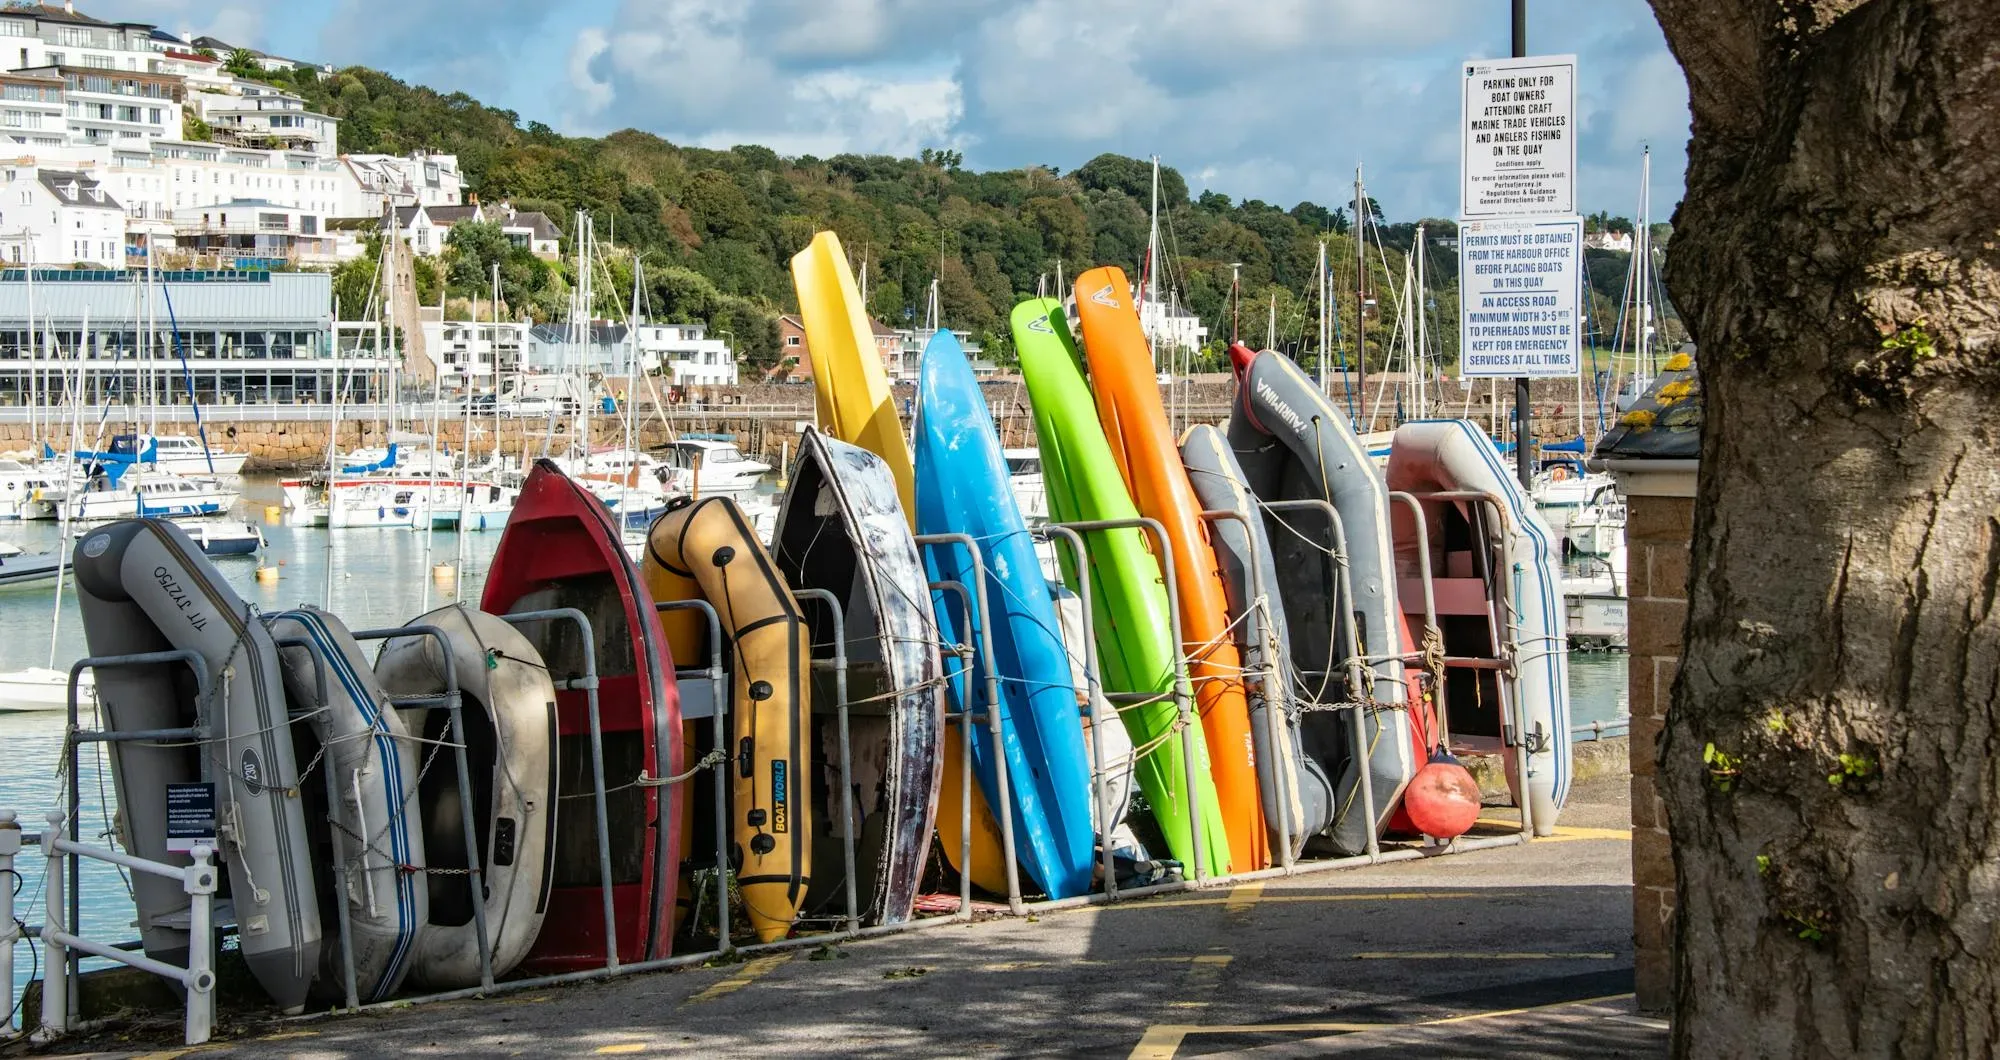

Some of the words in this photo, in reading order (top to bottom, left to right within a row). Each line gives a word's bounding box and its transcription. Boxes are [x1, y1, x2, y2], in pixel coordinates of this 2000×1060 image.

[1484, 78, 1515, 90] PARKING
[1518, 77, 1537, 88] ONLY
[1540, 76, 1554, 86] FOR
[1492, 92, 1510, 102] BOAT
[1514, 90, 1545, 102] OWNERS
[1484, 105, 1525, 116] ATTENDING
[1529, 103, 1552, 114] CRAFT
[1472, 120, 1499, 130] MARINE
[1504, 118, 1526, 129] TRADE
[1530, 116, 1565, 127] VEHICLES
[1476, 134, 1491, 143] AND
[1494, 131, 1528, 143] ANGLERS
[1531, 130, 1561, 141] FISHING
[1493, 146, 1503, 156] ON
[1506, 146, 1520, 155] THE
[1523, 144, 1543, 156] QUAY
[1466, 236, 1498, 246] PERMITS
[1500, 235, 1521, 245] MUST
[1524, 234, 1532, 244] BE
[1535, 233, 1572, 244] OBTAINED
[1469, 251, 1488, 260] FROM
[1492, 250, 1504, 260] THE
[1507, 249, 1541, 259] HARBOUR
[1544, 248, 1570, 258] OFFICE
[1476, 264, 1502, 274] BEFORE
[1504, 263, 1535, 273] PLACING
[1538, 262, 1562, 272] BOATS
[1494, 278, 1503, 288] ON
[1506, 278, 1522, 288] THIS
[1524, 277, 1544, 288] QUAY
[1482, 298, 1493, 308] AN
[1496, 297, 1530, 307] ACCESS
[1532, 296, 1556, 306] ROAD
[1470, 313, 1509, 323] MINIMUM
[1512, 312, 1539, 322] WIDTH
[1470, 327, 1480, 336] TO
[1482, 326, 1529, 336] PIERHEADS
[1532, 325, 1556, 335] MUST
[1560, 325, 1570, 335] BE
[1472, 341, 1493, 351] KEPT
[1496, 340, 1512, 350] FOR
[1515, 340, 1567, 350] EMERGENCY
[1470, 355, 1510, 366] SERVICES
[1512, 355, 1523, 364] AT
[1526, 354, 1540, 364] ALL
[1544, 354, 1570, 364] TIMES
[154, 566, 192, 610] JY2750
[187, 612, 207, 632] T/T
[775, 761, 785, 832] BOATWORLD
